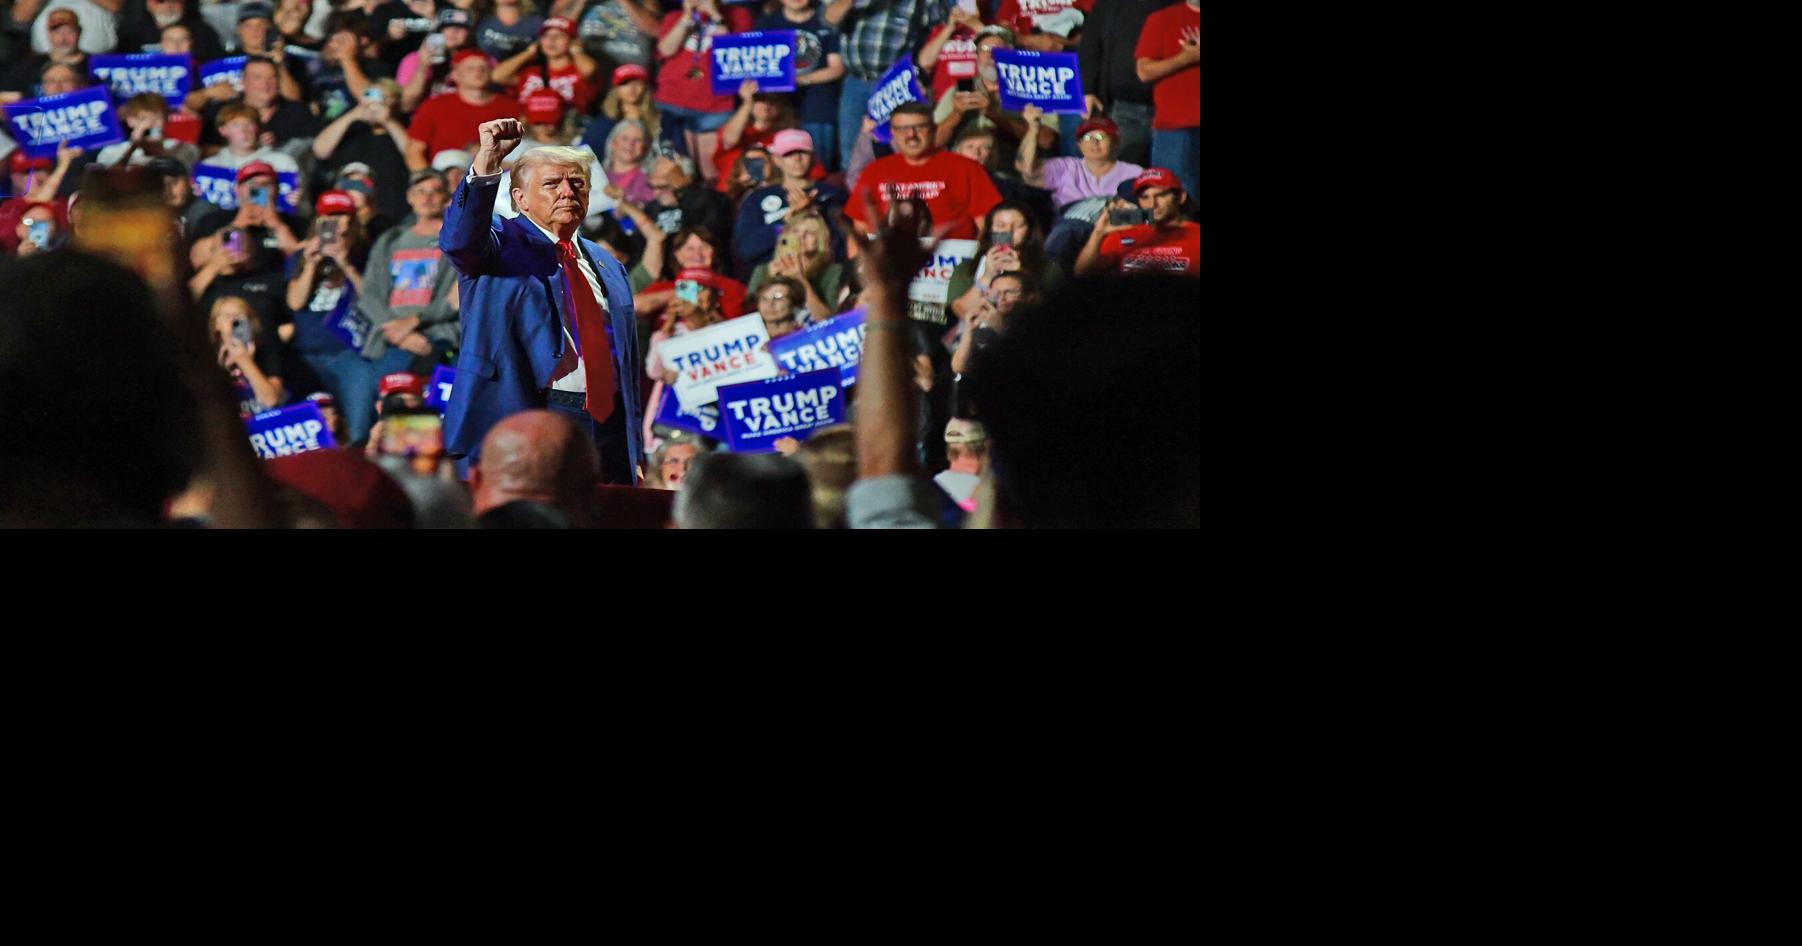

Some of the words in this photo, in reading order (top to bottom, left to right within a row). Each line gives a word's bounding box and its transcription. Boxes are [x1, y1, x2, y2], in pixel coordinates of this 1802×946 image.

[713, 44, 791, 65] TRUMP
[721, 58, 781, 76] VANCE
[997, 62, 1074, 83] TRUMP
[1006, 79, 1066, 97] VANCE
[12, 100, 108, 131] TRUMP
[672, 334, 760, 371] TRUMP
[689, 353, 757, 381] VANCE
[726, 385, 838, 421] TRUMP
[743, 404, 830, 433] VANCE
[249, 419, 323, 459] RUMP
[264, 438, 321, 459] ANCE
